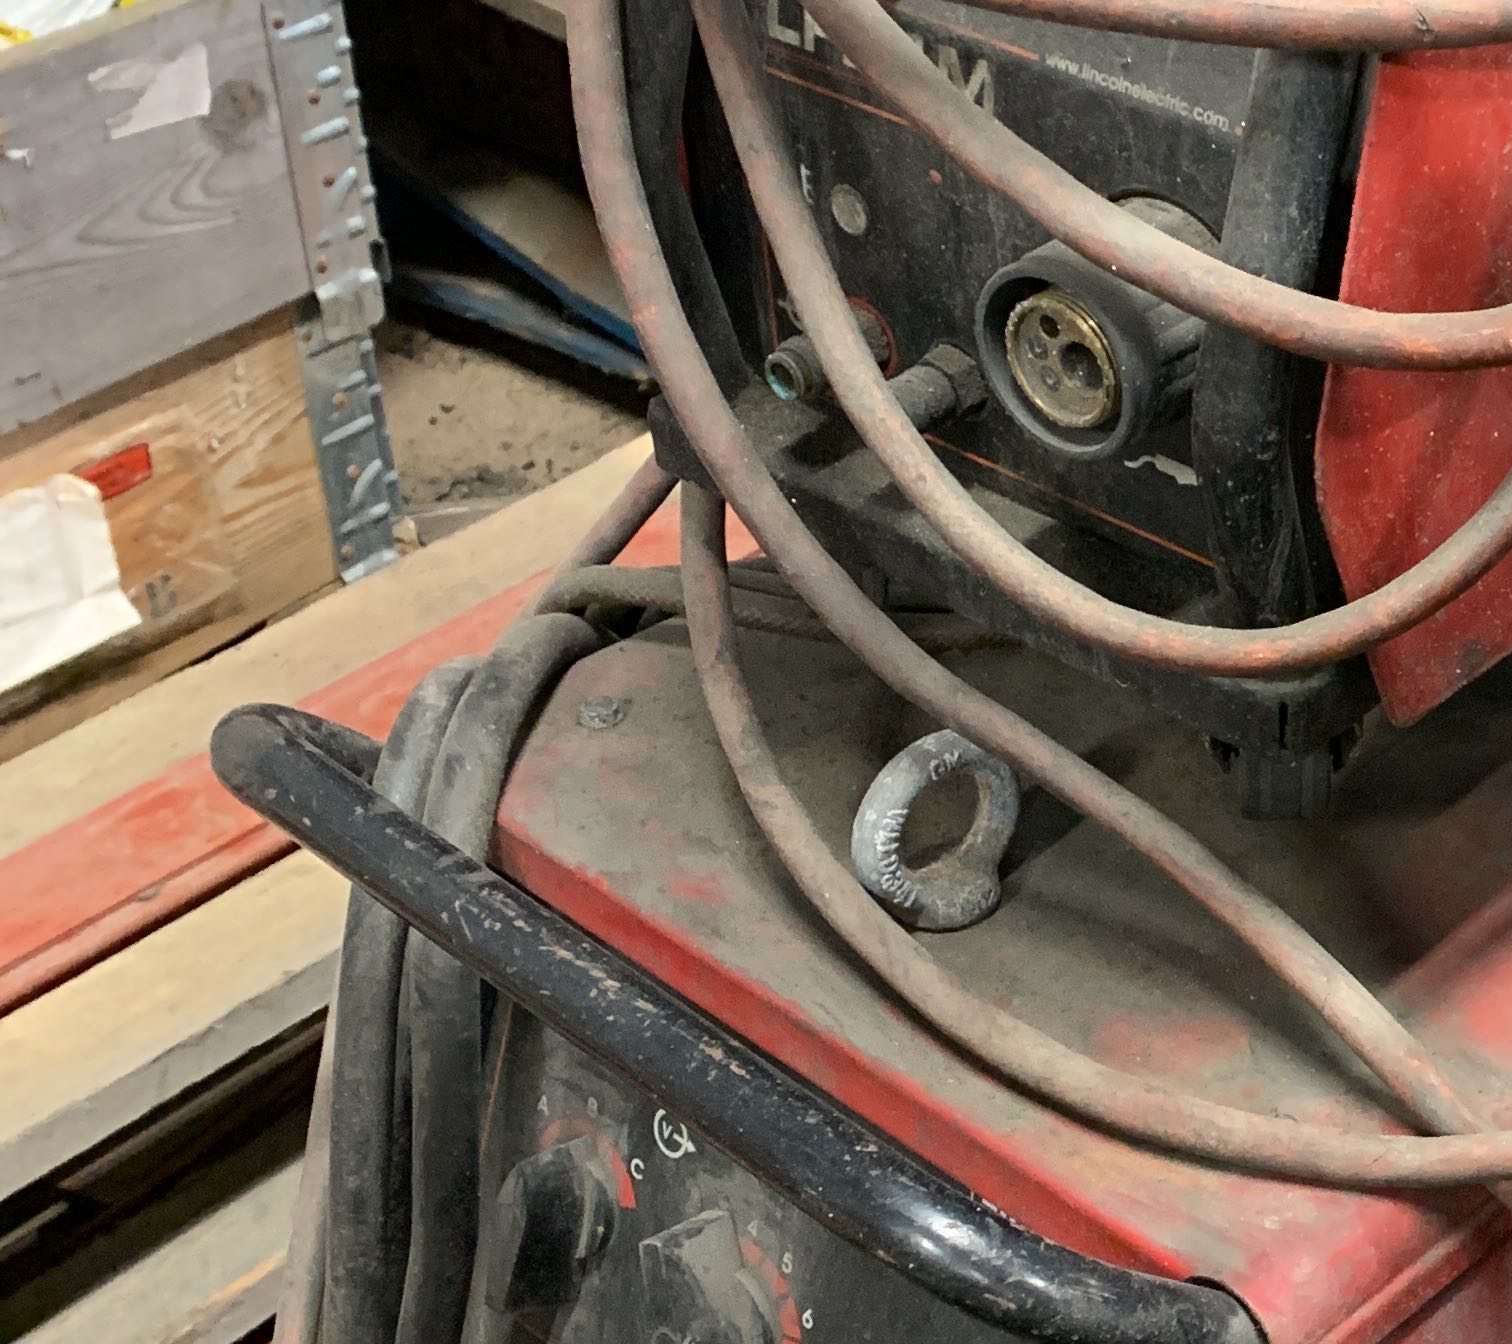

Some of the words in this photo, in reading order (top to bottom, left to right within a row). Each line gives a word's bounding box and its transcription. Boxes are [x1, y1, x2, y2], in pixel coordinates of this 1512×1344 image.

[537, 1095, 549, 1117] A
[630, 1158, 645, 1181] C
[781, 1253, 793, 1274] 5
[802, 1308, 814, 1329] 6
